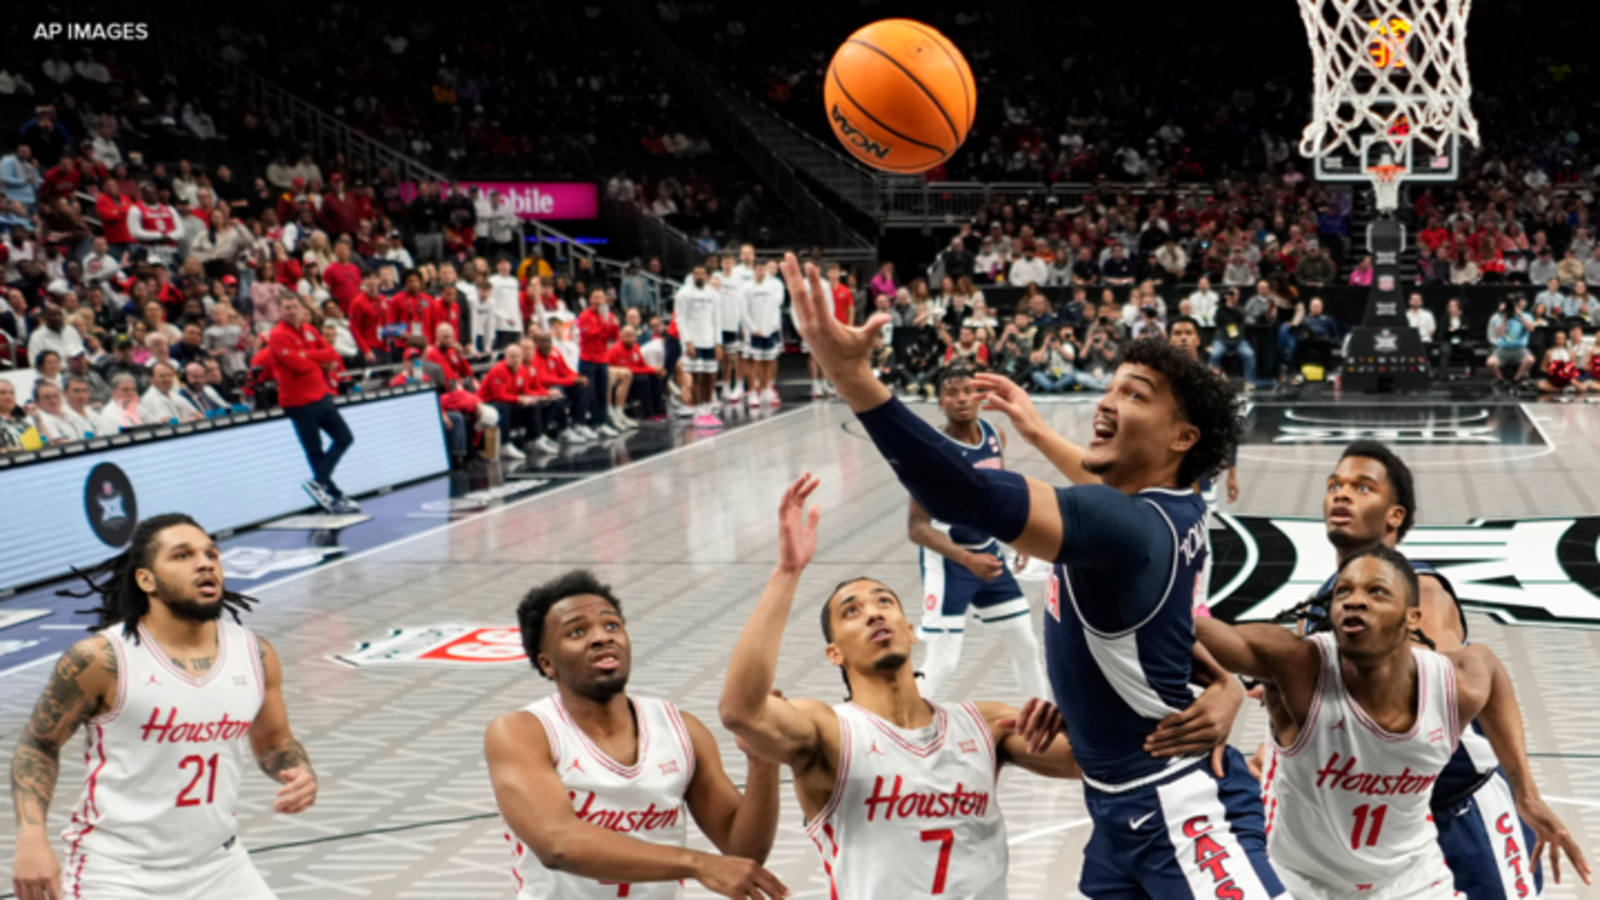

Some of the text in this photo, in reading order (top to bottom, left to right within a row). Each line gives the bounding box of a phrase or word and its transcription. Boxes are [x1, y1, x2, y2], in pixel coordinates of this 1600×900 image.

[831, 103, 891, 159] NCAA
[139, 705, 253, 744] Houston
[175, 753, 219, 808] 21
[864, 773, 989, 822] Houston
[1316, 751, 1437, 796] Houston
[1350, 804, 1389, 851] 11
[1495, 811, 1530, 899] CATS
[919, 828, 955, 896] 7
[1182, 814, 1245, 900] CATS
